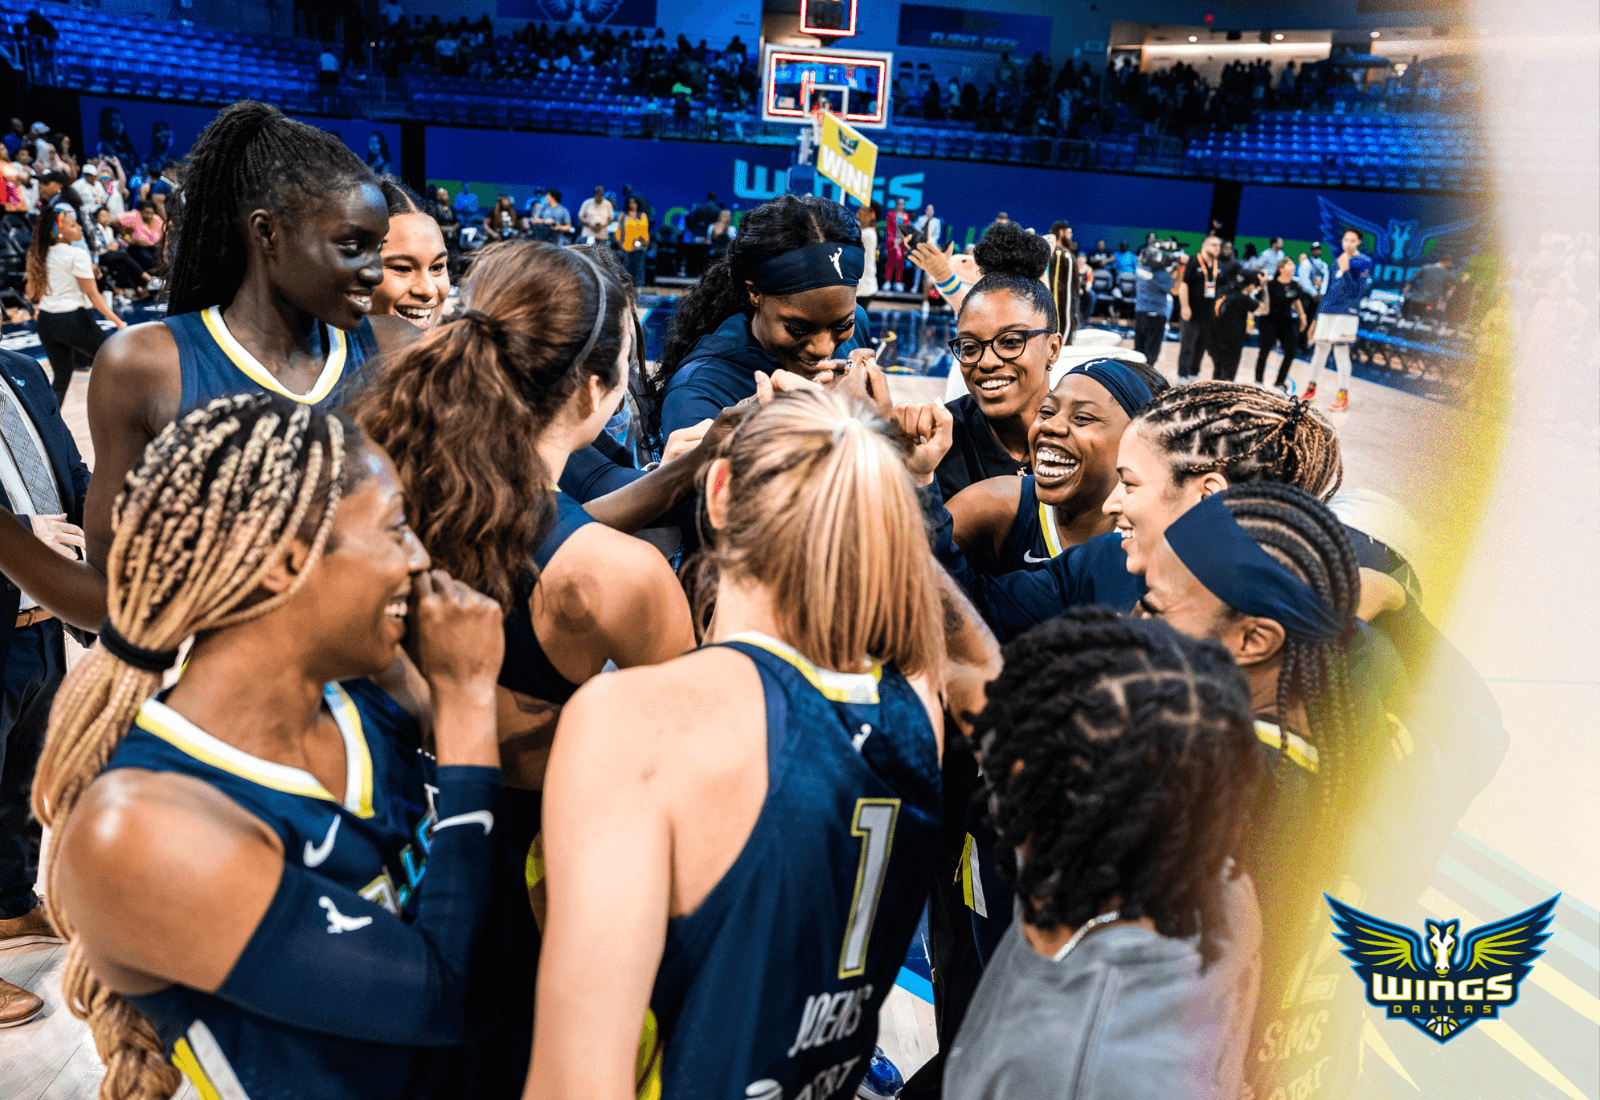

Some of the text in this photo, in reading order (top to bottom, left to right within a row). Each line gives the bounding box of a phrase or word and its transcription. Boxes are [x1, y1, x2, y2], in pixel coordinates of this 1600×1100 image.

[821, 144, 870, 200] WIN!
[837, 797, 902, 980] 1
[786, 983, 874, 1058] JOENS
[1258, 1009, 1330, 1062] SIMS
